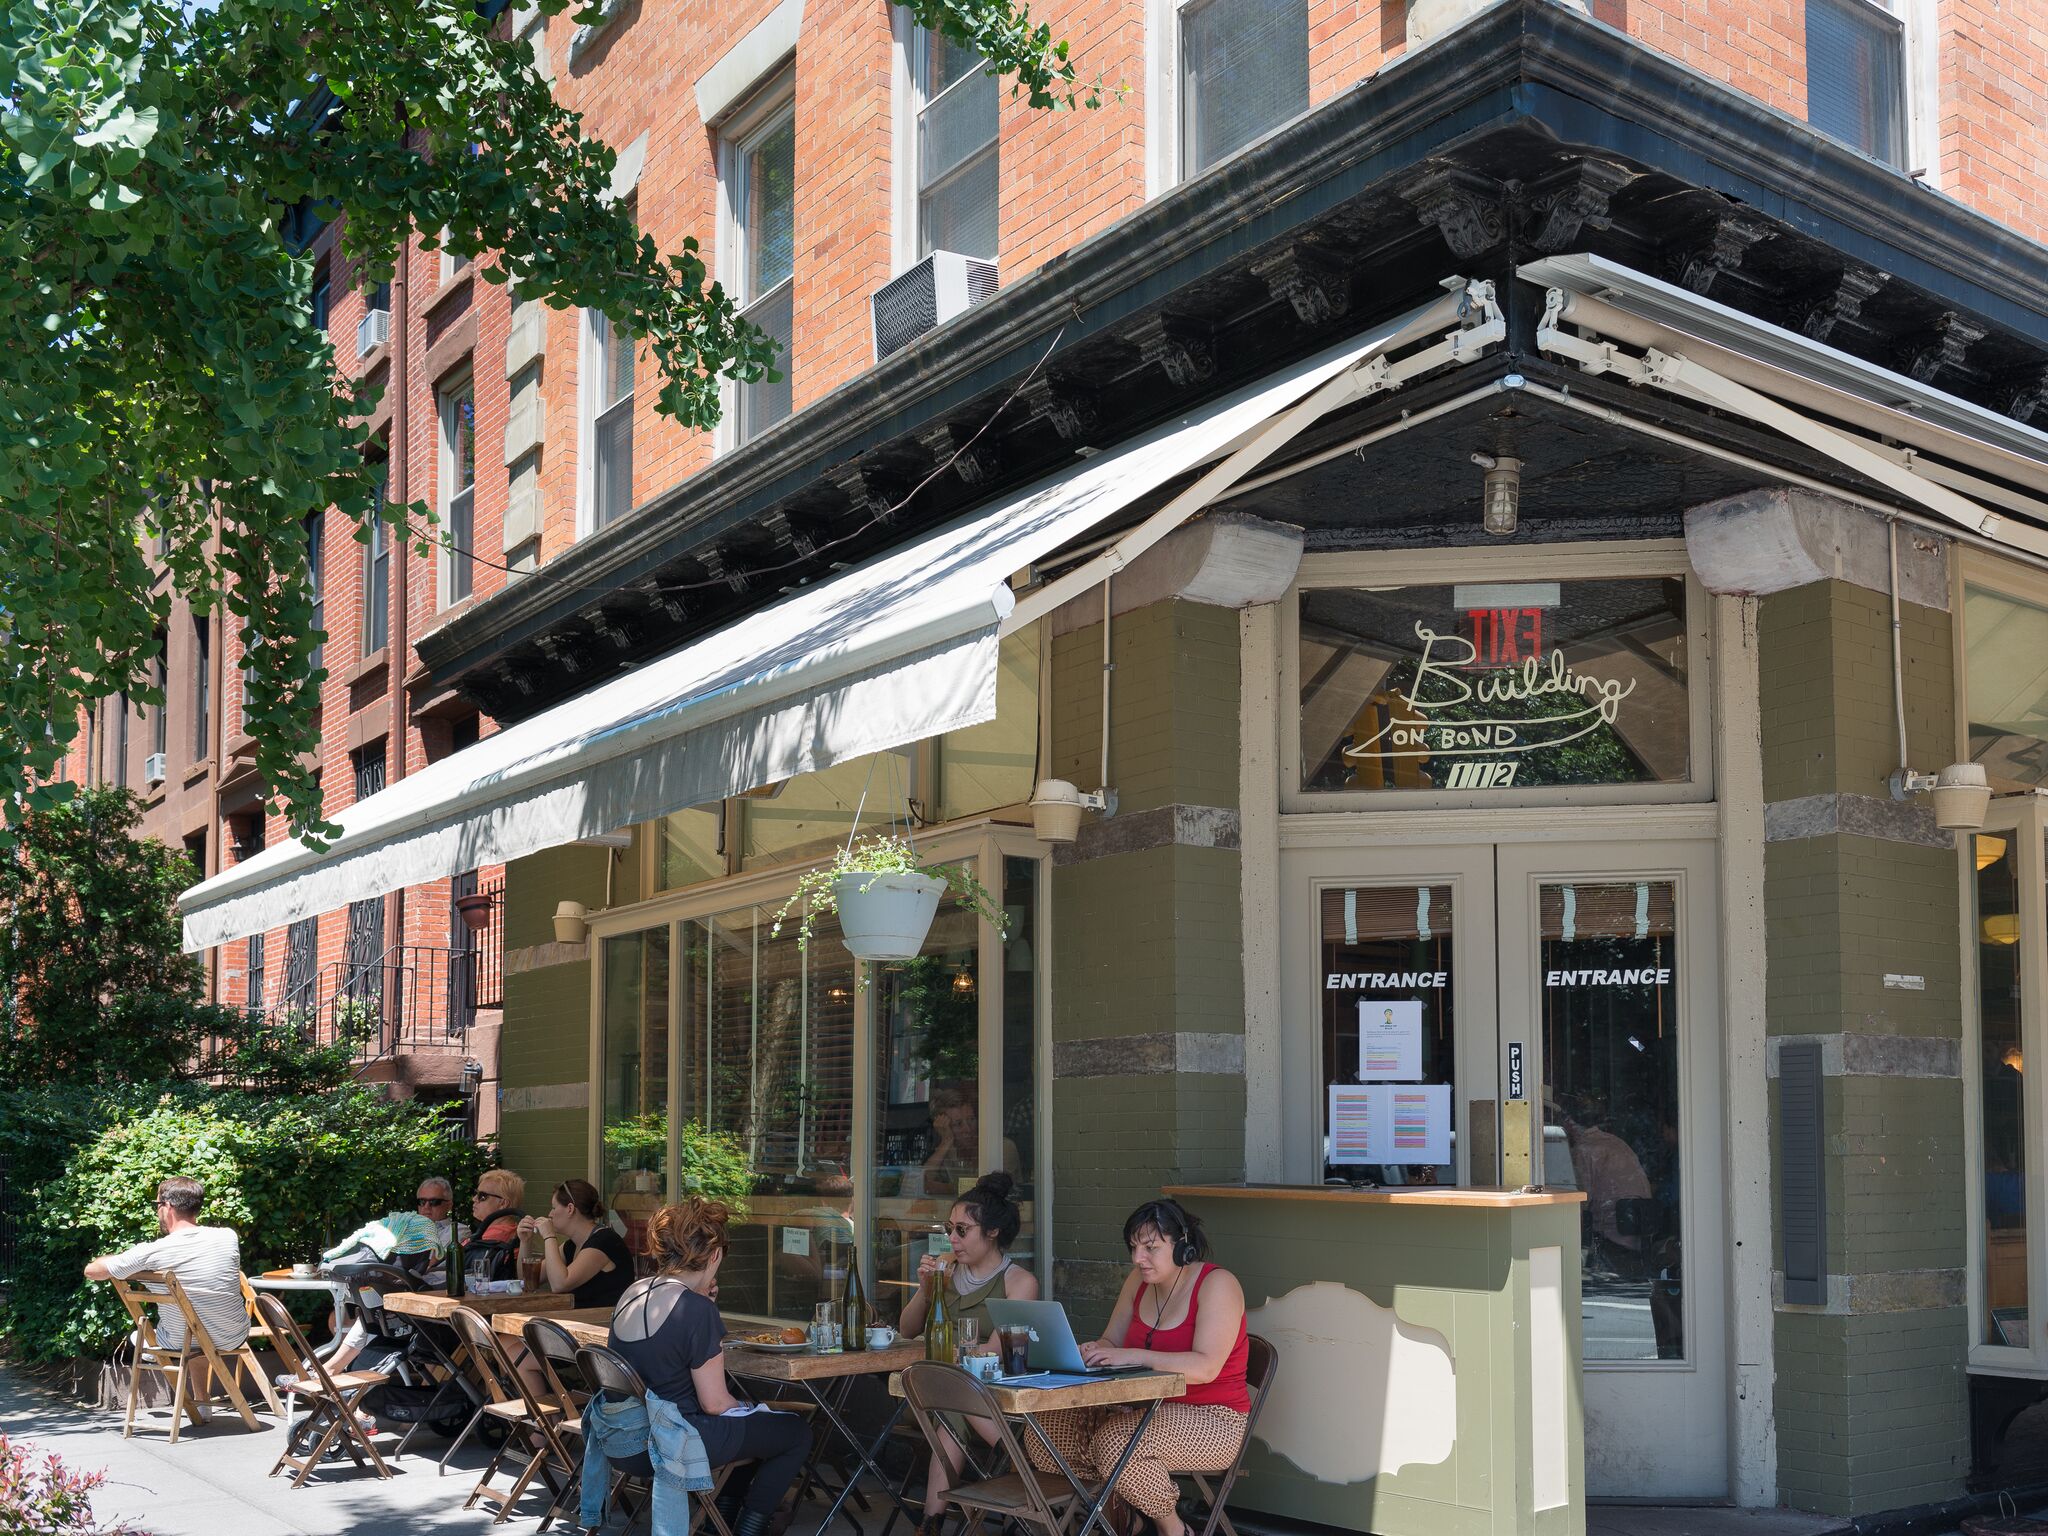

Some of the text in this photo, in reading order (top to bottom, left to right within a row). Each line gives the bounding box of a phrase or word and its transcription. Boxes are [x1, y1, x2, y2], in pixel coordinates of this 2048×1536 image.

[1399, 619, 1636, 724] Building
[1392, 725, 1517, 749] ON BOND
[1452, 763, 1513, 787] 112
[1326, 971, 1448, 990] ENTRANCE
[1546, 968, 1671, 987] ENTRANCE
[1510, 1047, 1521, 1095] PUSH
